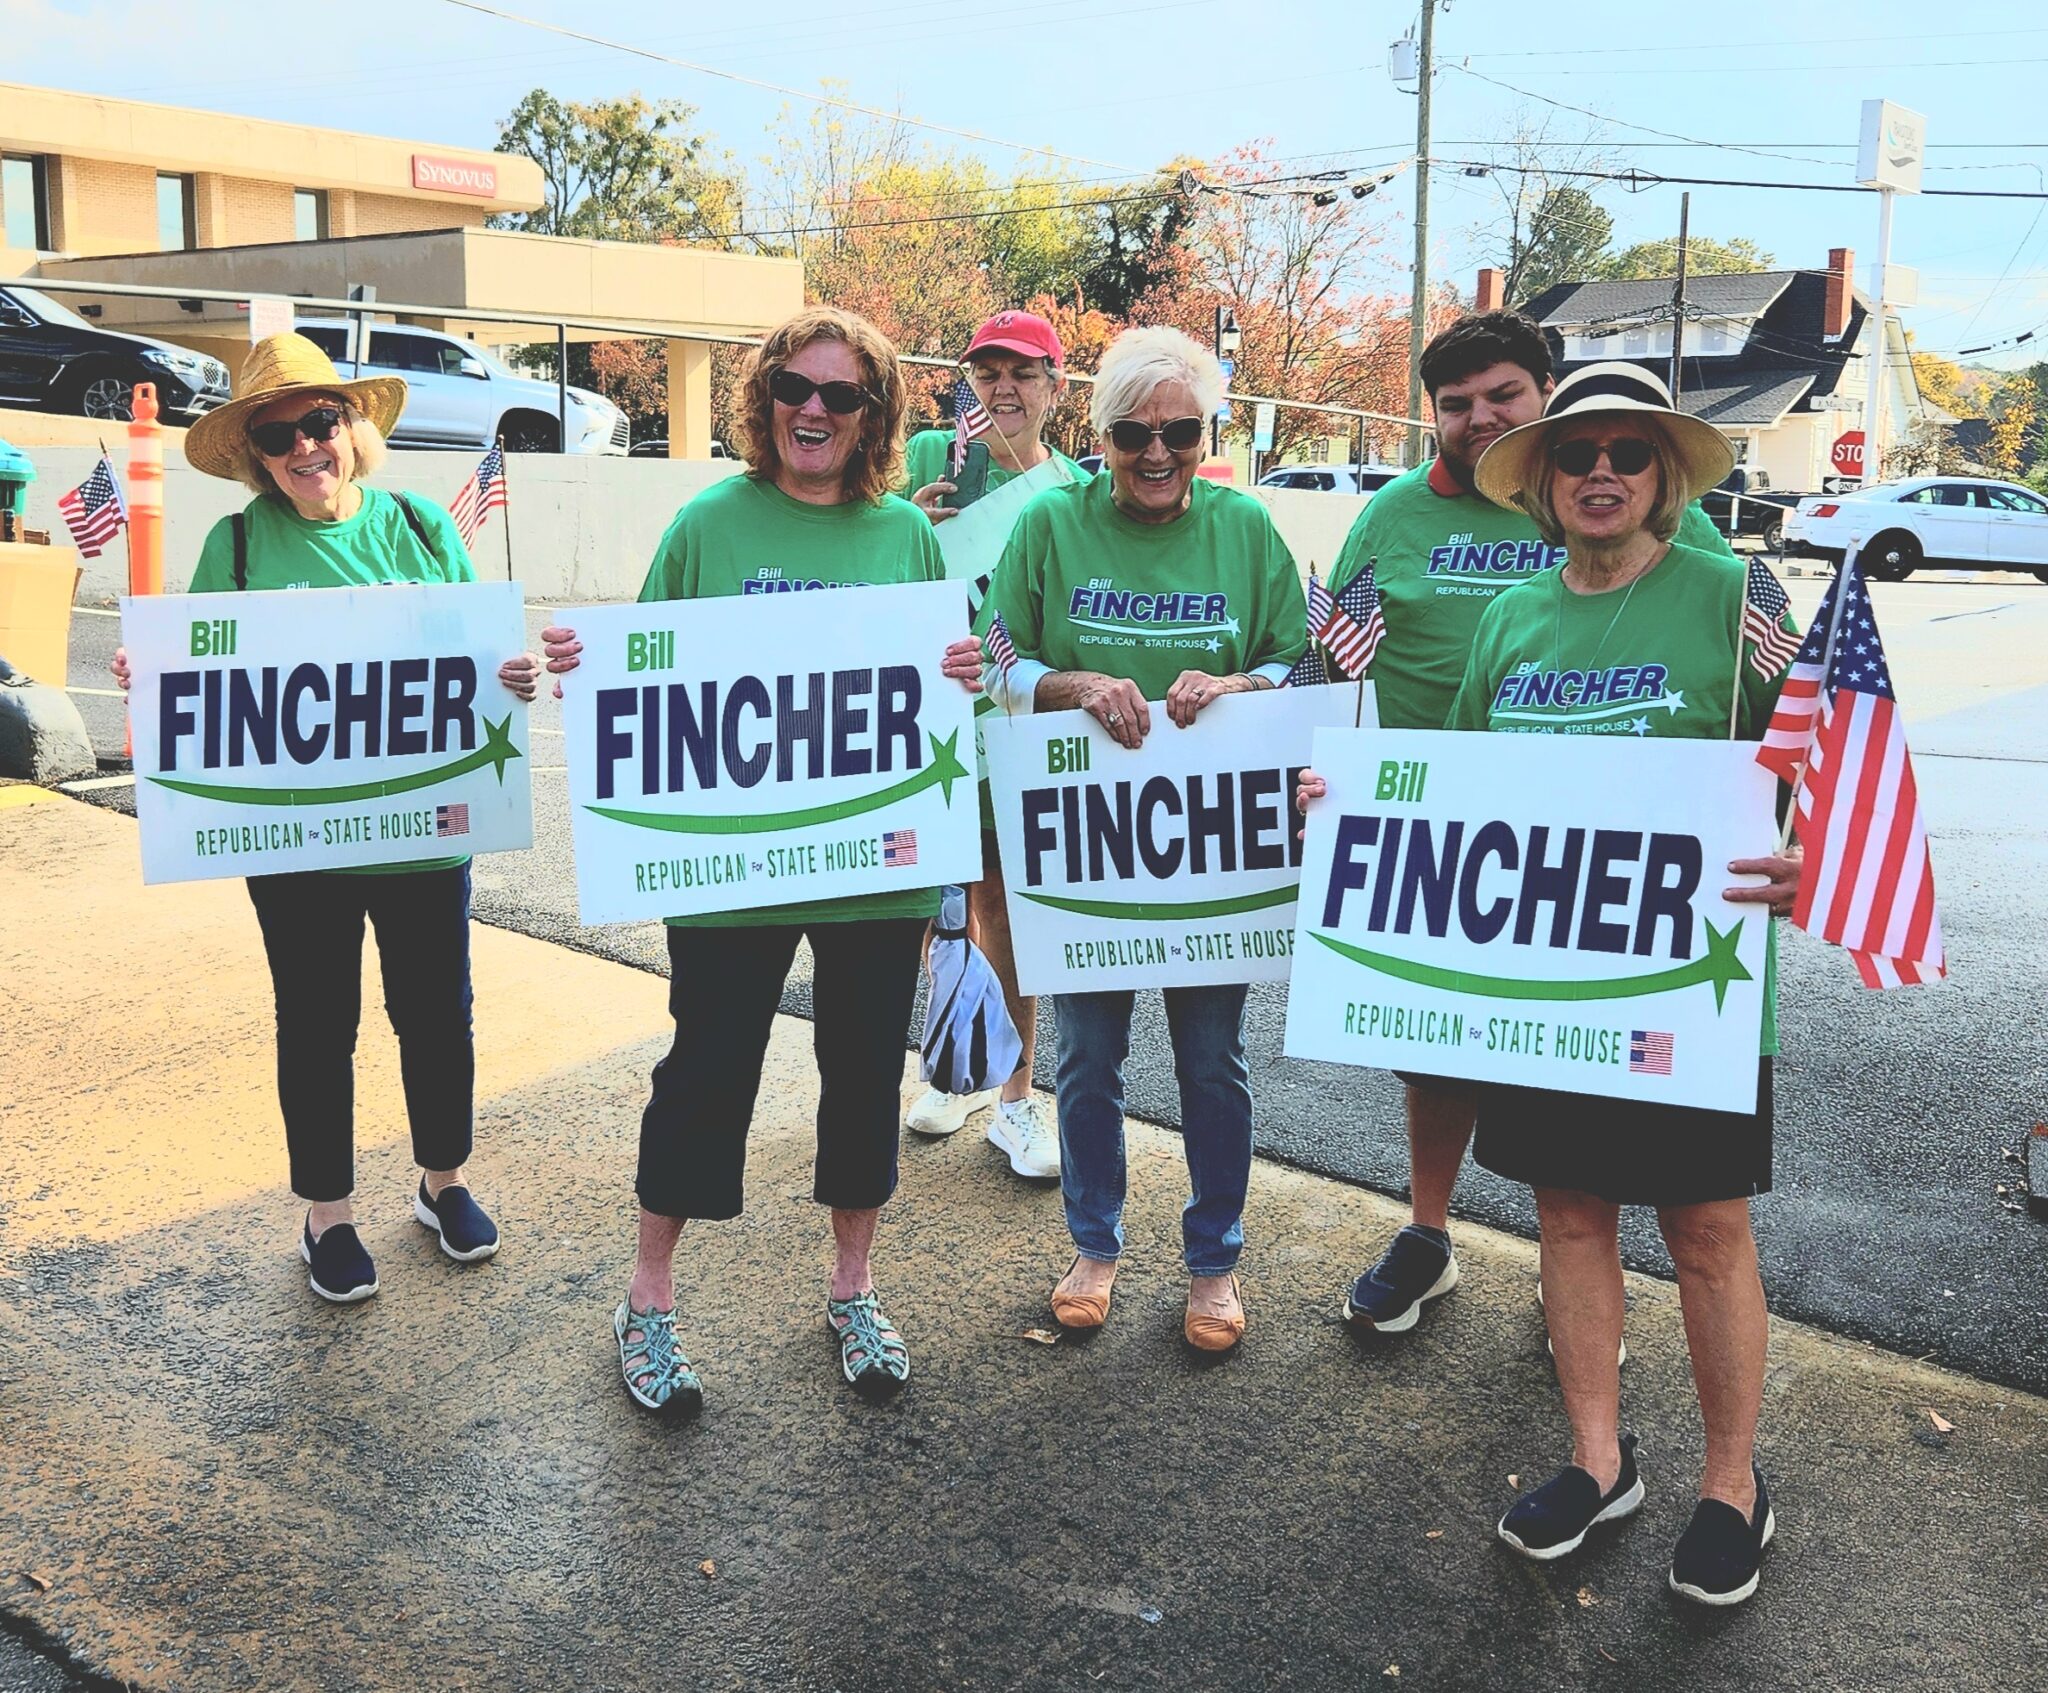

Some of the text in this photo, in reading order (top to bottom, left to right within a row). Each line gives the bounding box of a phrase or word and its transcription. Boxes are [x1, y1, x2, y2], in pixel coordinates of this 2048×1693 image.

[418, 160, 496, 190] SYNOVUS
[1834, 443, 1865, 463] STO
[1838, 482, 1855, 491] ONE
[1427, 540, 1569, 575] FINCHE
[1448, 532, 1473, 545] Bill
[757, 567, 782, 579] Bill
[1088, 577, 1113, 590] Bill
[1435, 586, 1496, 597] REPUBLICAN
[1069, 585, 1229, 624] FINCHER
[190, 619, 238, 657] Bill
[627, 630, 675, 673] Bill
[1079, 635, 1137, 647] REPUBLICAN
[1144, 638, 1172, 649] STATE
[1174, 638, 1206, 650] HOUSE
[1494, 663, 1669, 712] FINCHER
[159, 655, 478, 773] FINCHER
[596, 664, 923, 800] FINCHER
[1564, 724, 1594, 736] STATE
[1594, 719, 1632, 733] HOUSE
[1046, 735, 1091, 775] Bill
[1374, 760, 1429, 803] Bill
[195, 821, 303, 857] REPUBLICAN
[323, 815, 373, 846] STATE
[380, 810, 433, 841] HOUSE
[635, 852, 747, 893] REPUBLICAN
[766, 845, 817, 879] STATE
[824, 838, 879, 871] HOUSE
[1321, 813, 1704, 960] FINCHER
[1064, 937, 1167, 970] REPUBLICAN
[1185, 933, 1234, 962] STATE
[1241, 928, 1295, 959] HOUSE
[1344, 1001, 1464, 1047] REPUBLICAN
[1486, 1017, 1545, 1057] STATE
[1555, 1025, 1623, 1066] HOUSE
